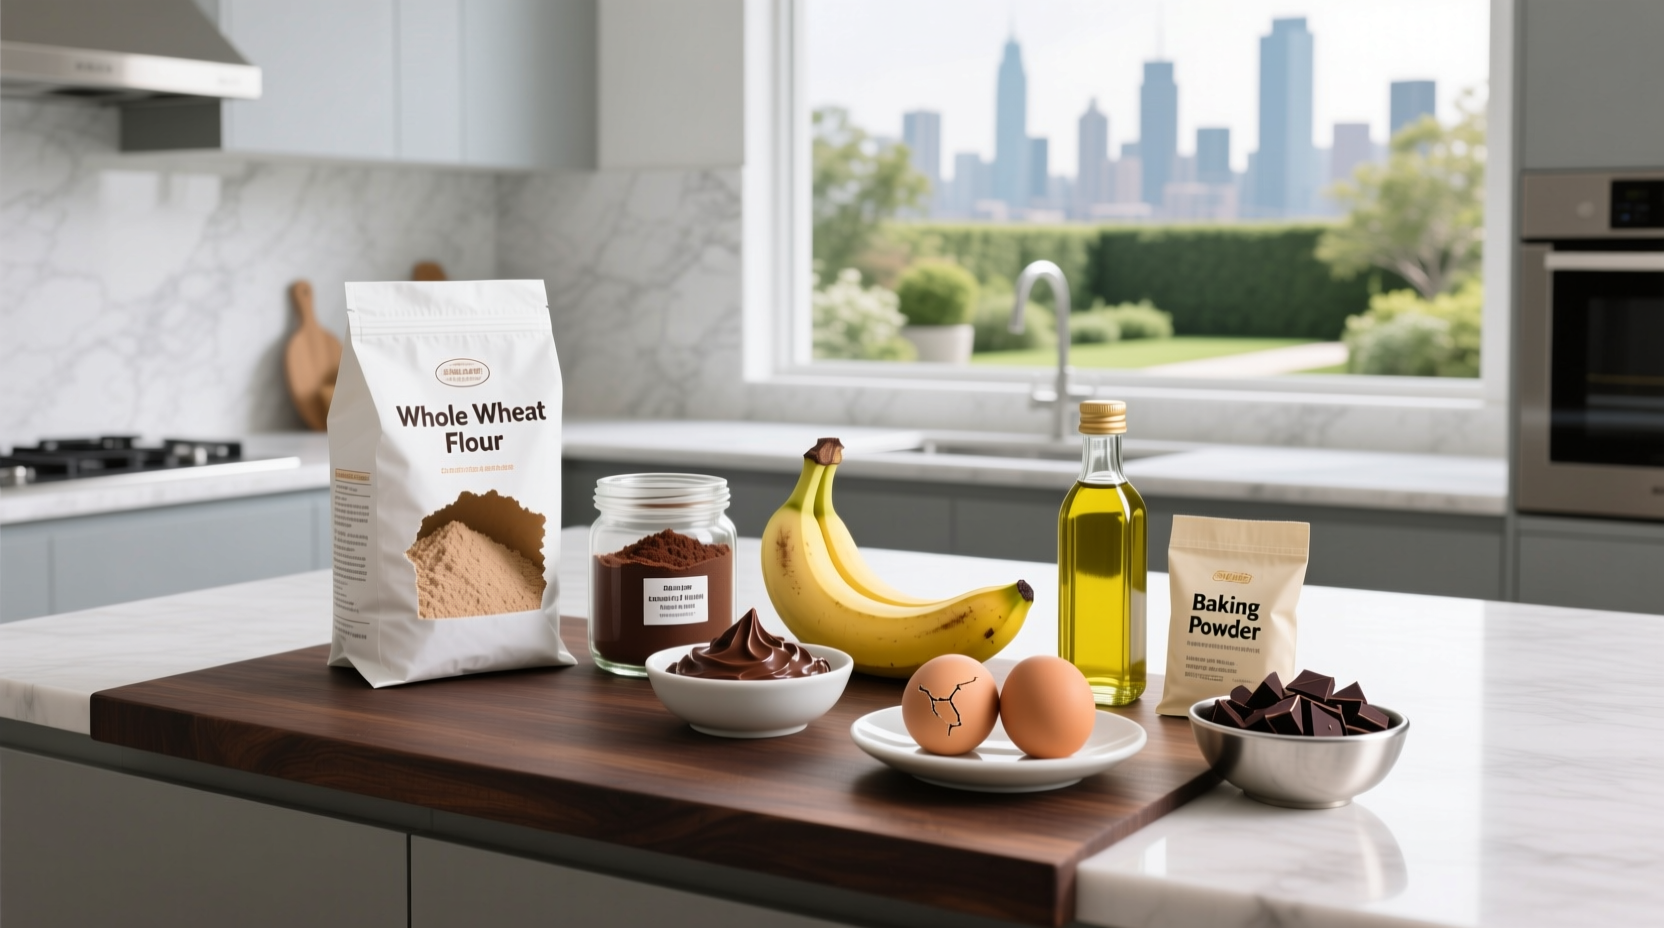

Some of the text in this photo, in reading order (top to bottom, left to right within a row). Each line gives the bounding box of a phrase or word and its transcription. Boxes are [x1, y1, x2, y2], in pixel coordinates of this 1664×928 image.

[396, 401, 547, 427] Whole Wheat
[445, 431, 503, 453] Flour
[1192, 593, 1260, 621] Baking
[1188, 615, 1261, 640] Powder
